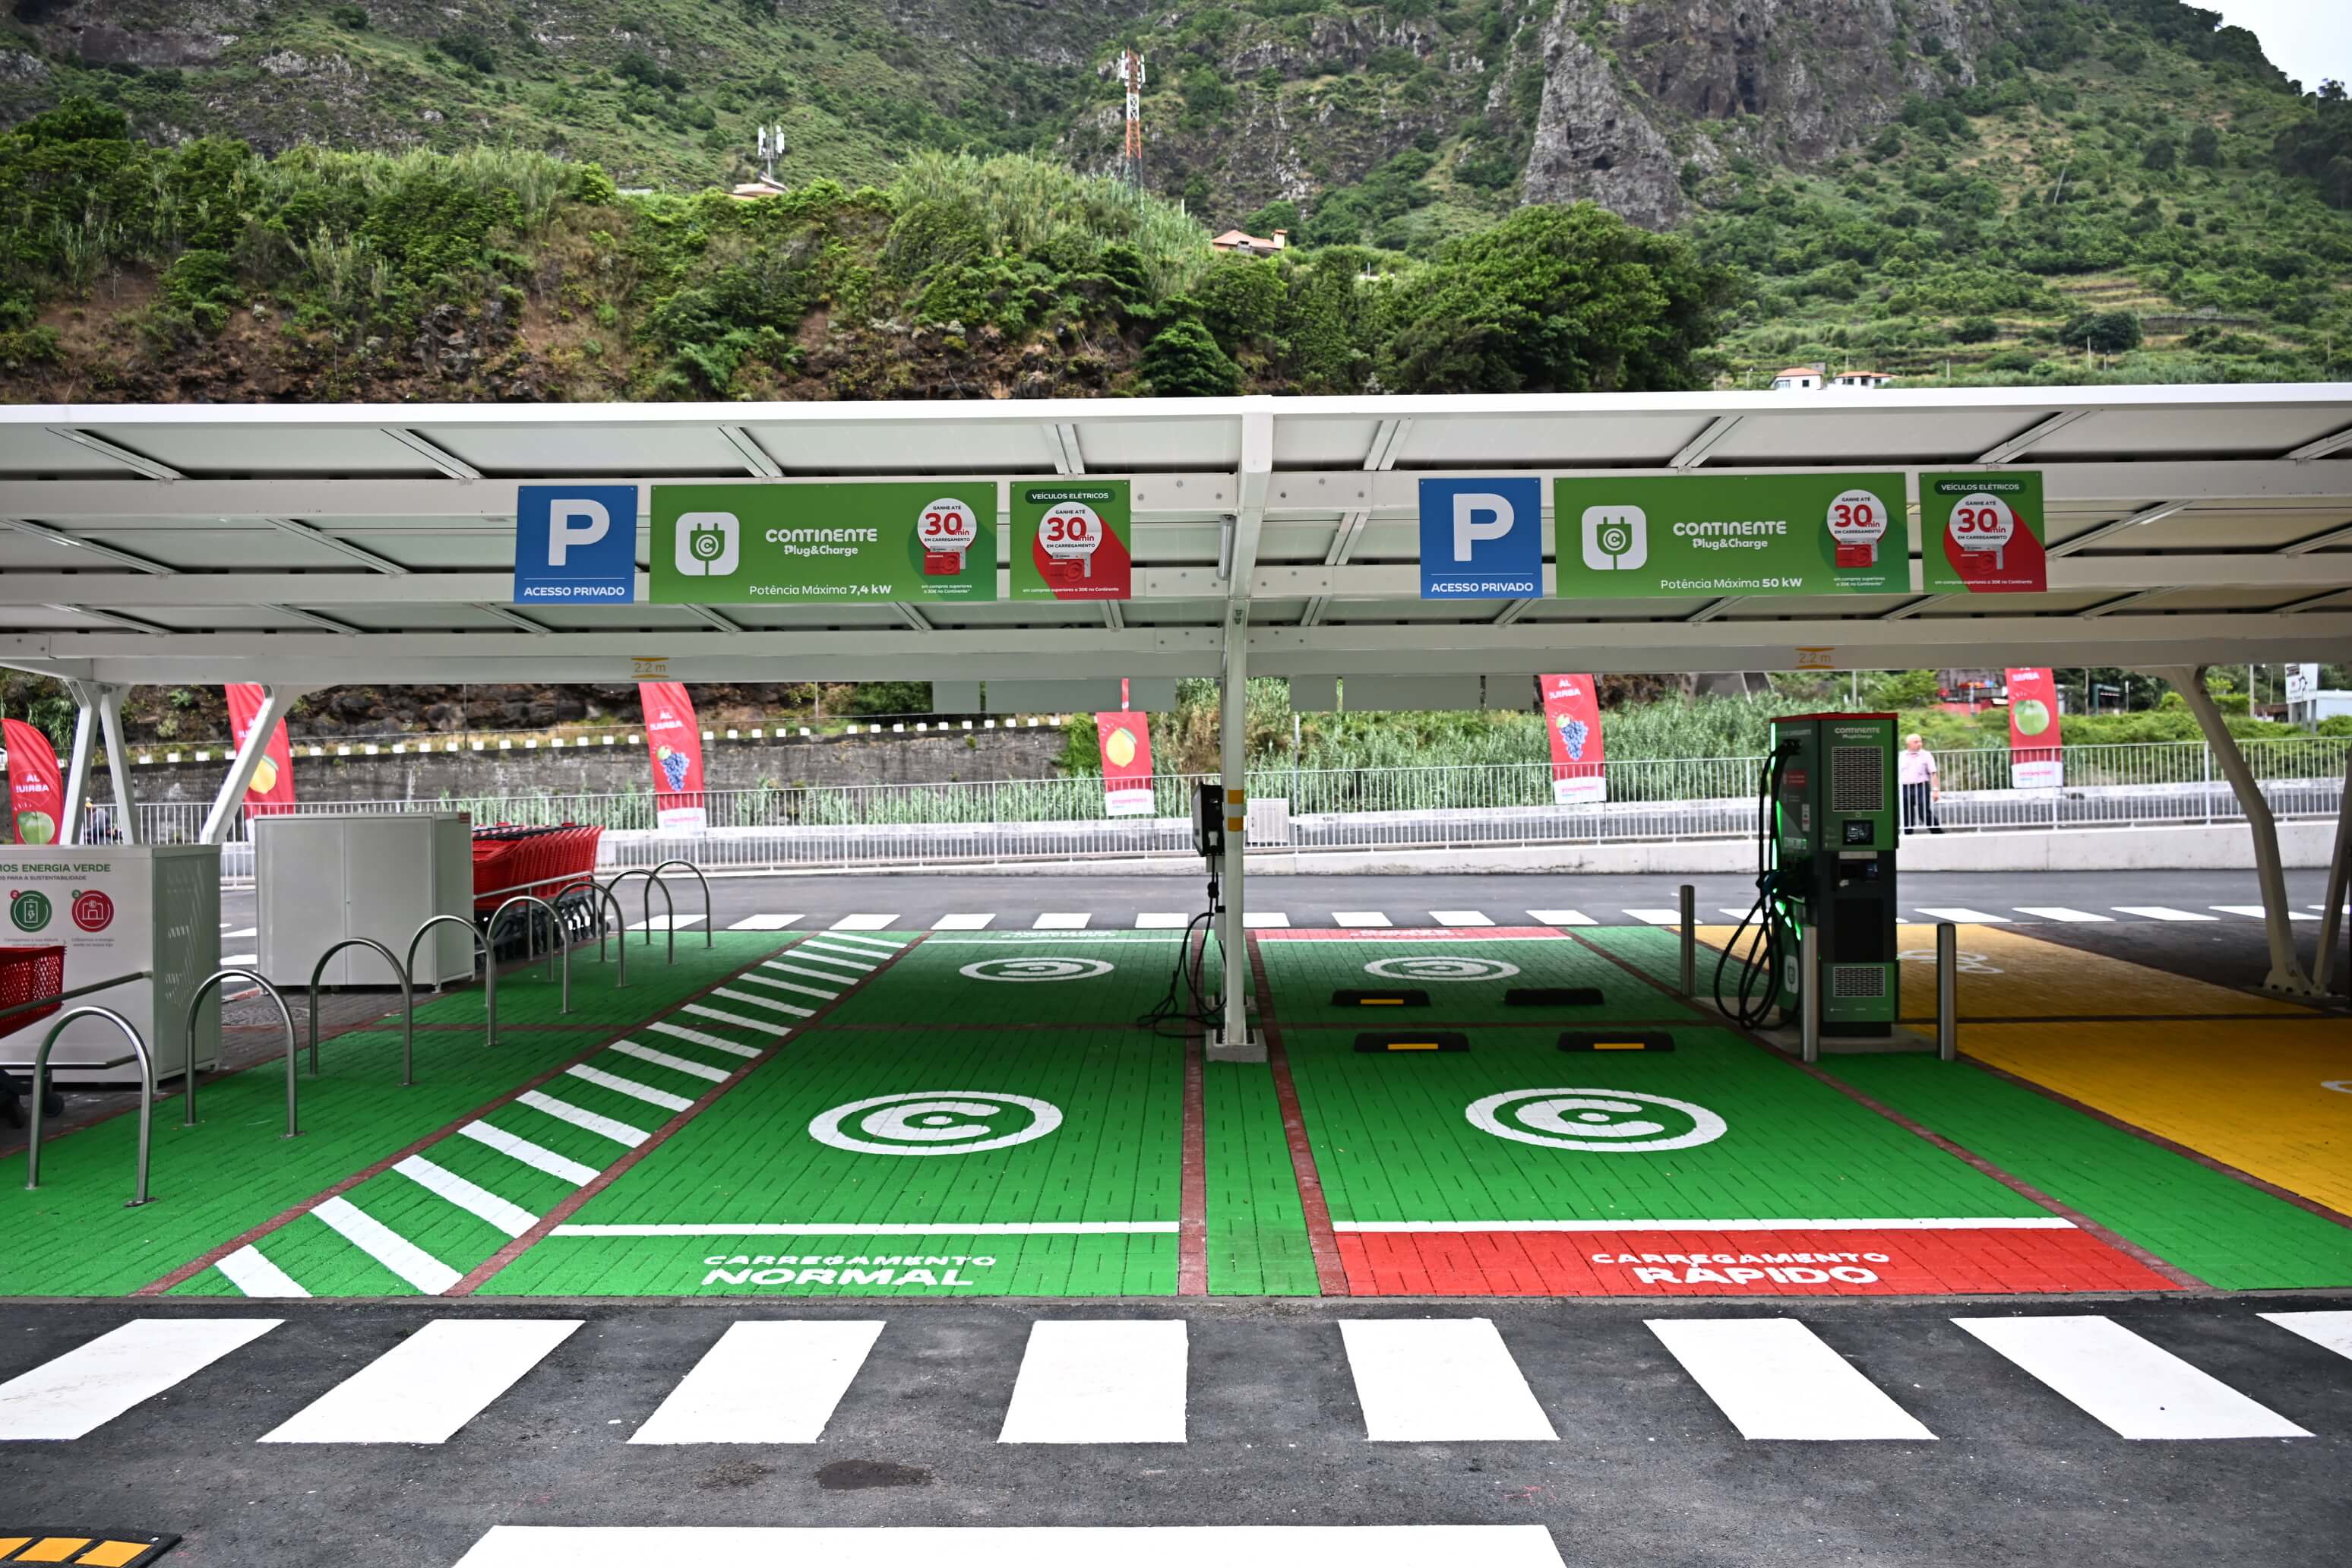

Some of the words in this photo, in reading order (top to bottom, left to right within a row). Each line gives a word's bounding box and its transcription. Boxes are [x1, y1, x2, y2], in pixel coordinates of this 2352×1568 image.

[1834, 504, 1873, 527] 30
[1957, 508, 1998, 533] 30
[925, 512, 963, 536] 30
[1047, 517, 1086, 541] 30
[1453, 493, 1515, 562] P
[1673, 520, 1788, 536] CONTINENTE
[548, 499, 610, 566] P
[765, 528, 877, 542] CONTINENTE
[1692, 538, 1769, 550] Plug&Charge
[784, 545, 858, 557] Plug&Charge
[749, 585, 799, 596] Potência
[802, 583, 847, 595] Máxima
[849, 585, 869, 596] 7,4
[871, 584, 892, 594] kW
[1431, 583, 1479, 593] ACESSO
[1481, 582, 1534, 593] PRIVADO
[1661, 578, 1711, 590] Potência
[1714, 577, 1759, 588] Máxima
[1762, 578, 1779, 588] 50
[1782, 577, 1803, 587] kW
[523, 586, 571, 597] ACESSO
[573, 586, 625, 597] PRIVADO
[1799, 653, 1816, 662] 2.2
[634, 662, 653, 673] 2.2
[21, 864, 71, 872] ENERGIA
[74, 864, 111, 872] VERDE
[703, 1255, 997, 1266] CARREGAMENTO
[1592, 1252, 1889, 1264] CARREGAMENTO
[701, 1268, 974, 1285] NORMAL
[1633, 1263, 1879, 1284] RÁPIDO
